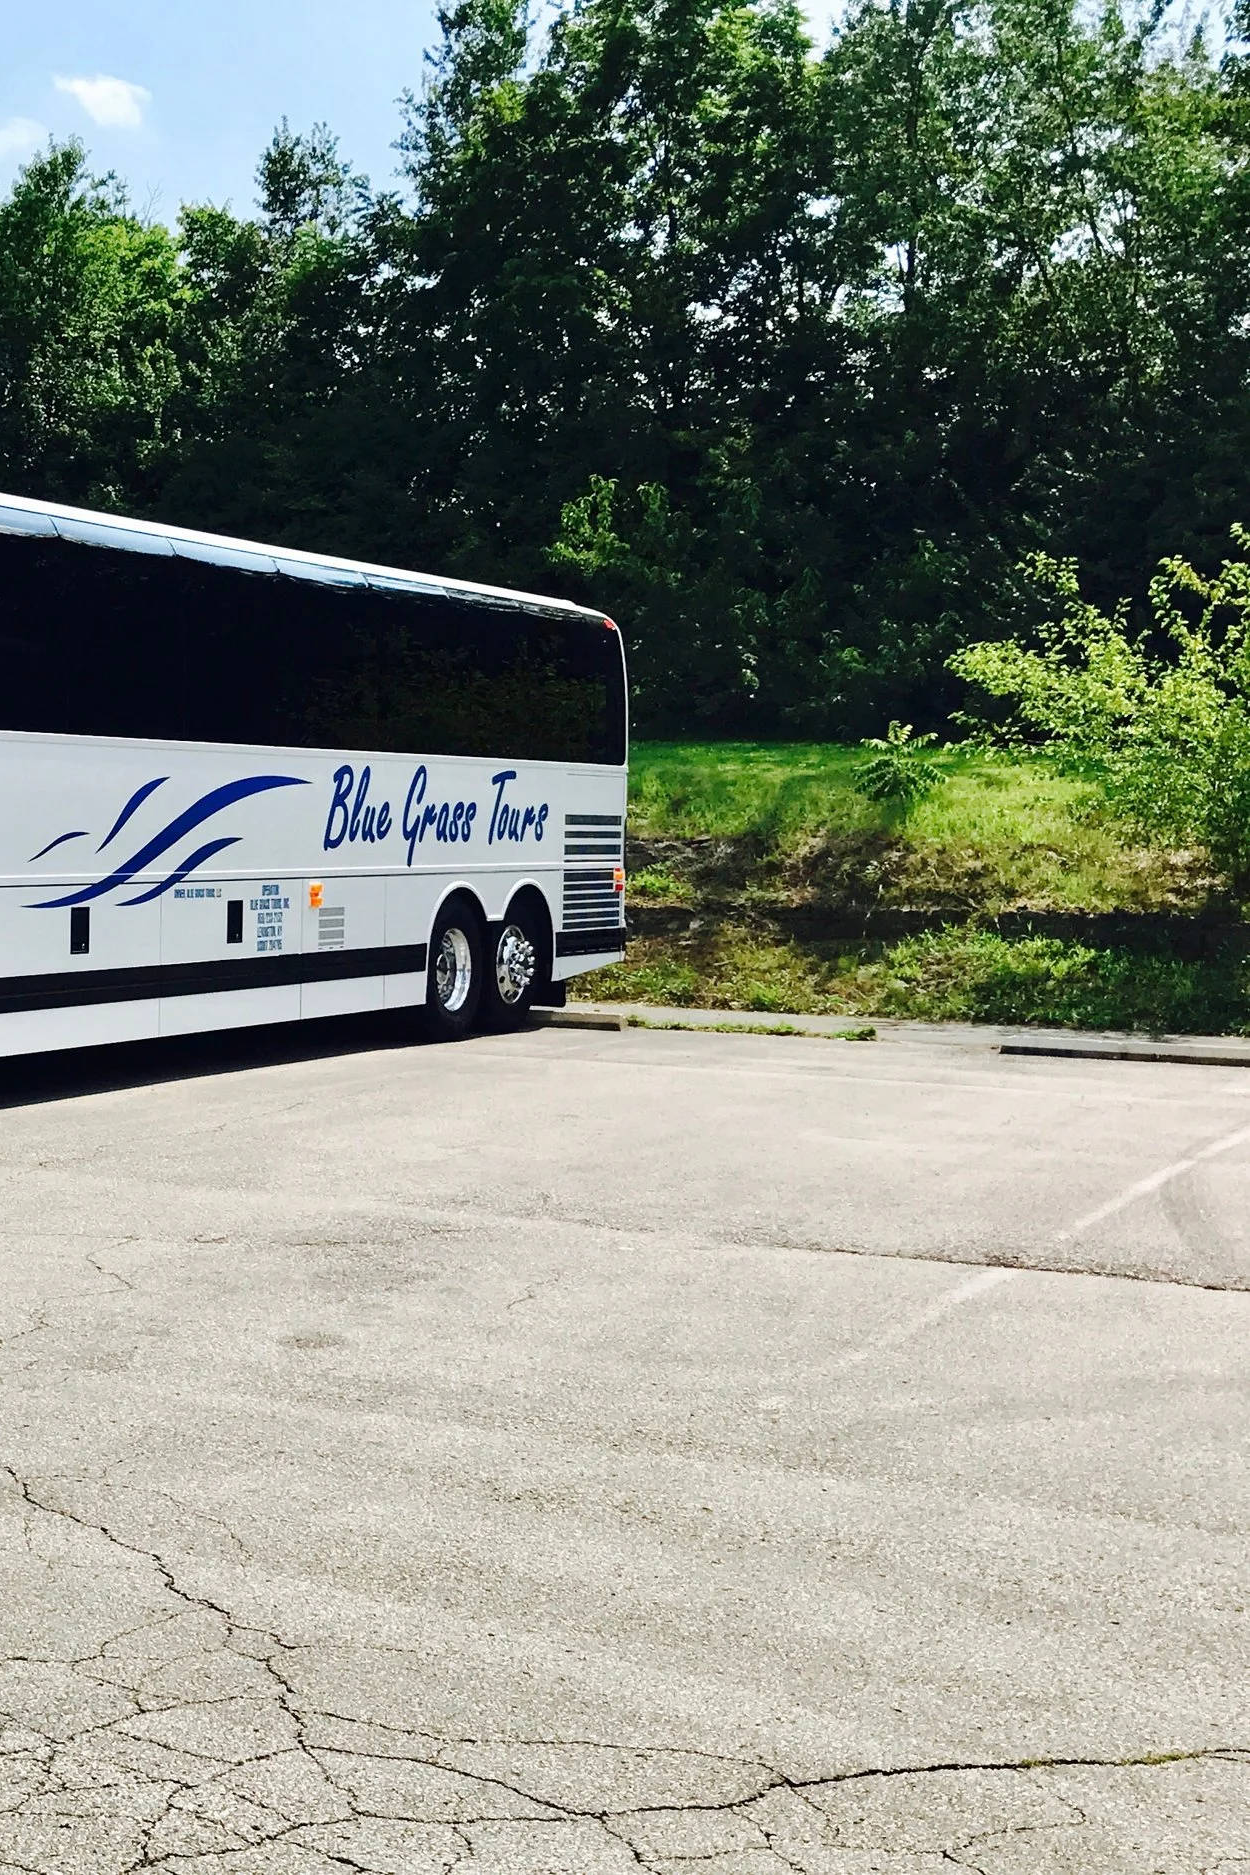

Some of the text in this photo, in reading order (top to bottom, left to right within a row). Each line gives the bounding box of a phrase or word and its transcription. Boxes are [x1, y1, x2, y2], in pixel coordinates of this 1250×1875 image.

[323, 764, 549, 868] Blue Grass Tours
